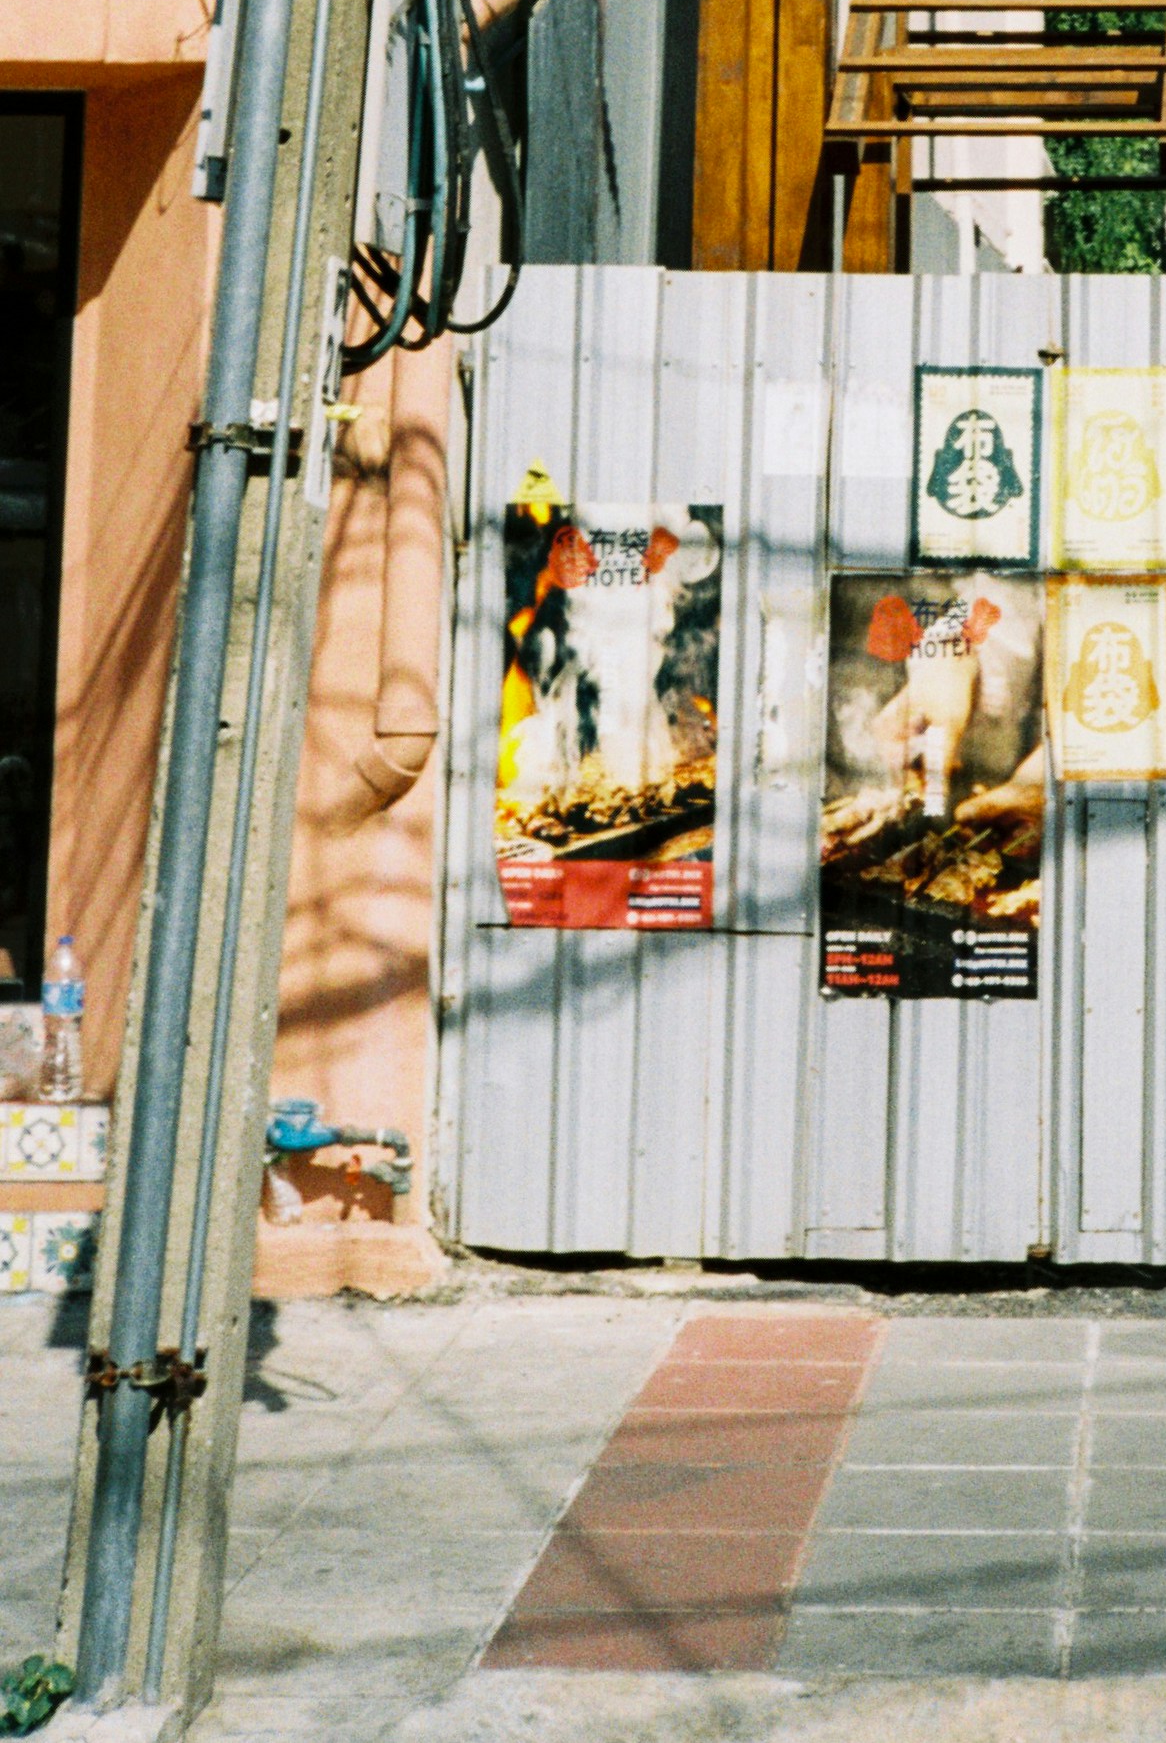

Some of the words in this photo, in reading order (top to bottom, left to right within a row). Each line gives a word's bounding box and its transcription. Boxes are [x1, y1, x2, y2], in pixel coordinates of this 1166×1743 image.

[946, 414, 1000, 515] 布袋
[588, 528, 649, 558] 布袋
[910, 598, 970, 630] 布袋
[1084, 627, 1139, 728] 布袋
